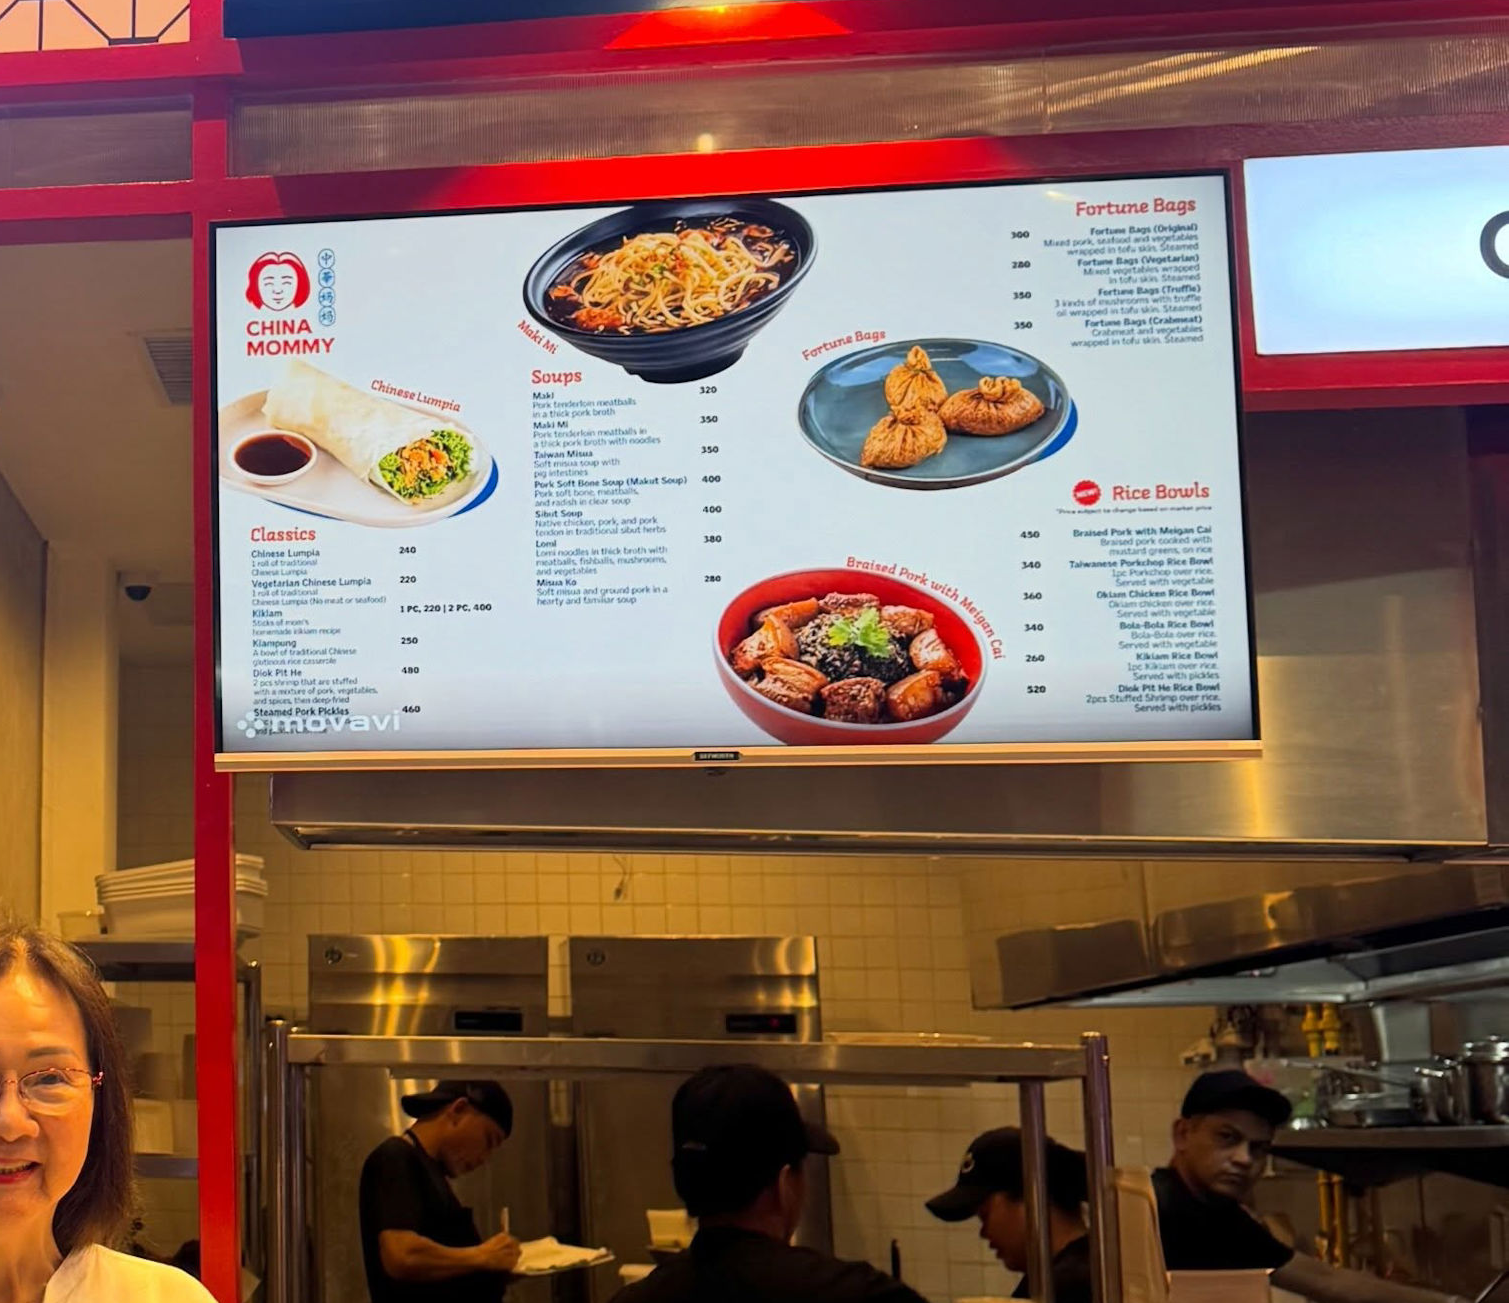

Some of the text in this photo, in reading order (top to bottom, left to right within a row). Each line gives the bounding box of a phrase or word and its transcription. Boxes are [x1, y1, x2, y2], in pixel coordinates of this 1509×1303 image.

[1076, 197, 1196, 216] Fortune Bags
[1090, 223, 1198, 235] Fortune Bags (Original)
[1077, 253, 1199, 267] Fortune Bags (Vegetarian)
[1098, 288, 1134, 296] Fortune
[1136, 286, 1160, 296] Bags
[246, 319, 313, 336] CHINA
[1084, 319, 1121, 328] Fortune
[1123, 317, 1147, 327] Bags
[518, 320, 559, 354] Maki Mi
[247, 338, 335, 356] MOMMY
[802, 330, 886, 361] Fortune Bags
[531, 370, 582, 386] Soups
[371, 379, 461, 412] Chinese Lumpia
[534, 450, 565, 459] Taiwan
[534, 480, 554, 489] Pork
[556, 479, 575, 488] Soft
[577, 479, 600, 487] Bone
[601, 478, 624, 488] Soup
[661, 475, 687, 486] Soup)
[1112, 482, 1210, 501] Rice Bowls
[560, 509, 583, 518] Soup
[251, 527, 316, 543] Classics
[1072, 528, 1108, 537] Braised
[1110, 528, 1132, 536] Pork
[1134, 527, 1157, 536] with
[1196, 525, 1212, 534] Cai
[250, 548, 320, 558] Chinese Lumpia
[1068, 557, 1213, 568] Taiwanese Porkchop Rice Bowl
[251, 577, 371, 589] Vegetarian Chinese Lumpia
[1128, 589, 1166, 598] Chicken
[1168, 589, 1188, 597] Rice
[1190, 588, 1215, 597] Bowl
[846, 556, 1006, 660] Braised Pork with Meigan Cai
[1167, 620, 1187, 628] Rice
[1189, 619, 1214, 628] Bowl
[1171, 651, 1192, 660] Rice
[1194, 651, 1218, 660] Bowl
[1172, 683, 1193, 692] Rice
[1195, 682, 1220, 692] Bowl
[253, 707, 292, 717] Steamed
[295, 707, 316, 716] Pork
[272, 711, 401, 732] movavi
